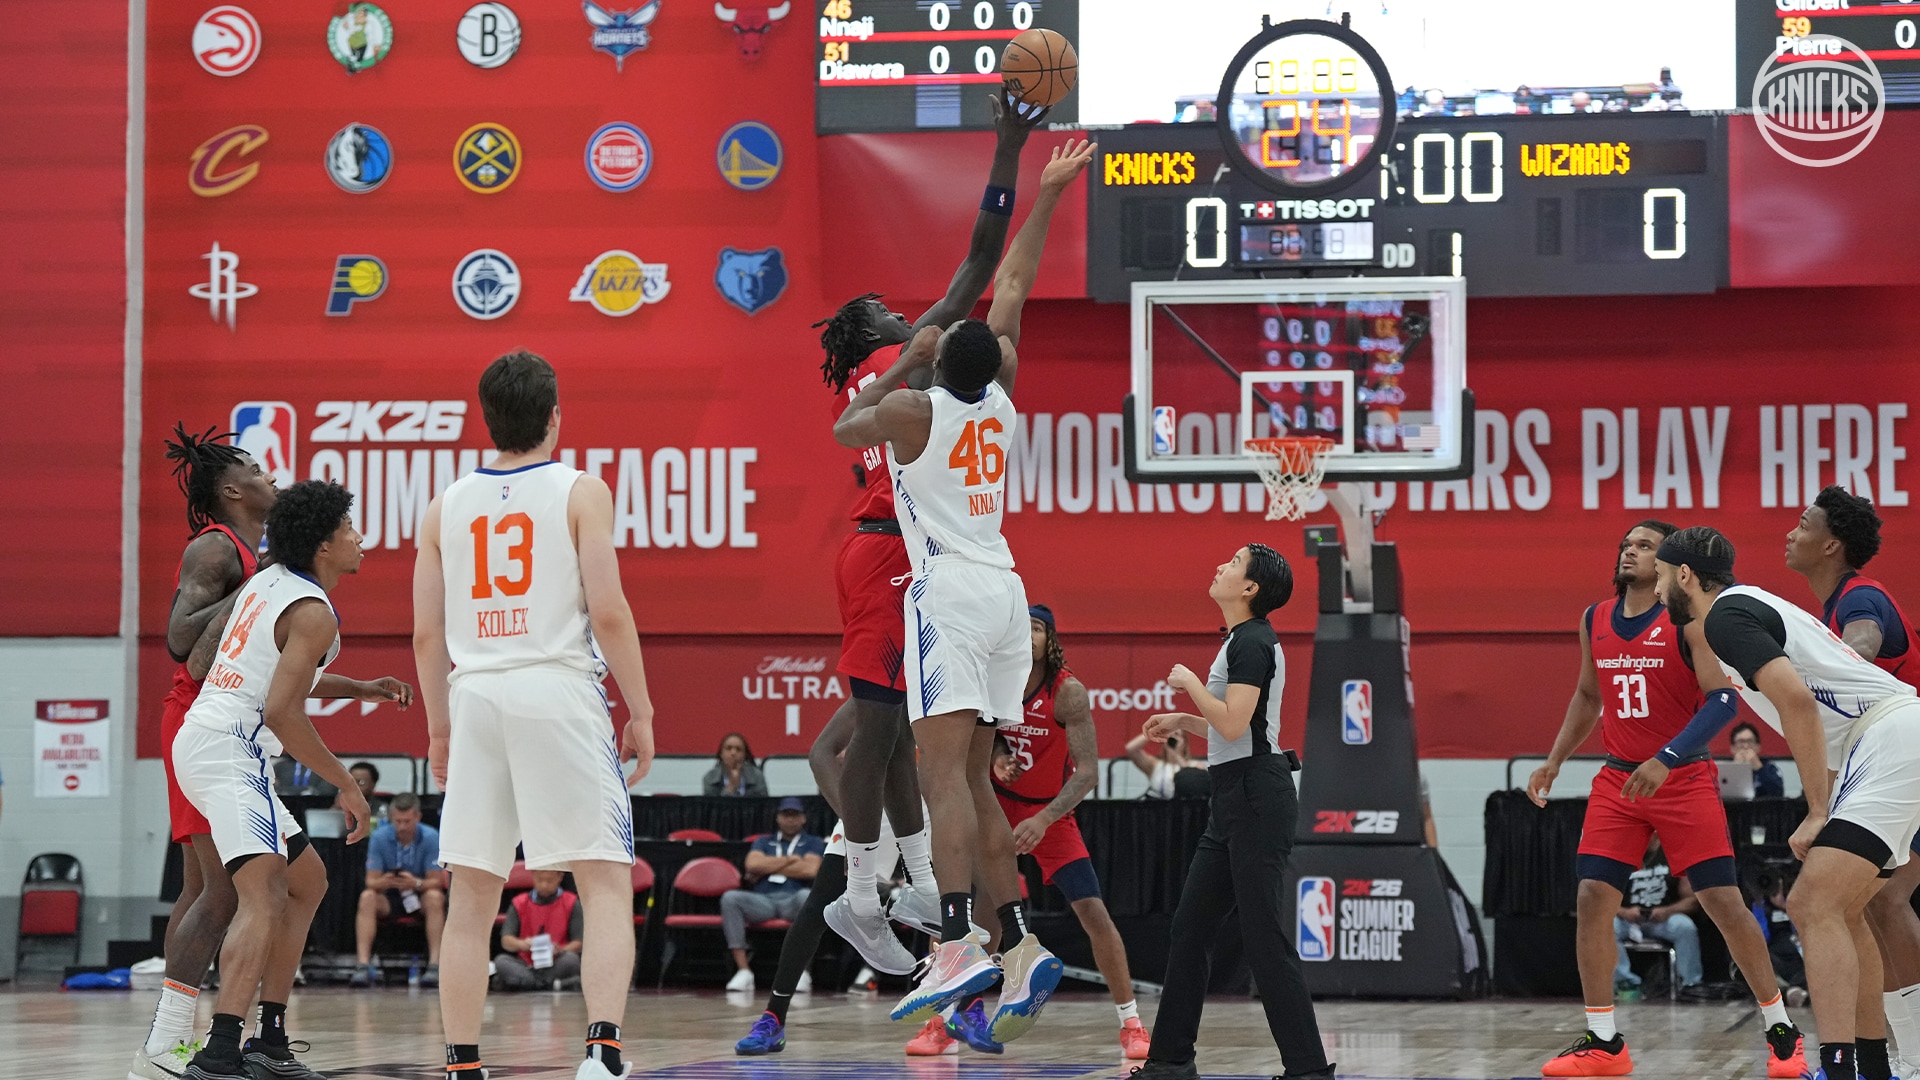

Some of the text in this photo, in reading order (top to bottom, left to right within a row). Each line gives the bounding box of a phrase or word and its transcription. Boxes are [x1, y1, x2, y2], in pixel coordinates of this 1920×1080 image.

[823, 0, 852, 18] 46
[929, 1, 1033, 31] 0 0 0
[820, 18, 874, 40] Nnaji
[1782, 16, 1811, 37] 59
[1895, 19, 1917, 49] 0
[824, 42, 849, 62] 51
[929, 45, 996, 74] 0 0
[1776, 36, 1842, 56] Pierre
[820, 61, 904, 80] Diawara
[1104, 151, 1196, 186] KNICKS
[1520, 142, 1631, 177] WIZARDS
[1276, 199, 1376, 219] TISSOT
[1644, 188, 1686, 260] 0
[1186, 197, 1228, 268] 0
[310, 401, 467, 442] 2K26
[949, 417, 1004, 487] 46
[1581, 406, 1731, 509] PLAY
[1759, 403, 1909, 507] HERE
[470, 512, 534, 599] 13
[221, 592, 267, 660] 14
[477, 607, 529, 638] KOLEK
[1596, 653, 1664, 672] washington
[742, 676, 845, 700] ULTRA
[1088, 680, 1176, 711] rosoft
[1613, 674, 1650, 718] 33
[1313, 811, 1400, 834] 2K26
[1342, 879, 1403, 896] 2K26
[1339, 900, 1415, 931] SUMMER
[1339, 931, 1403, 961] LEAGUE
